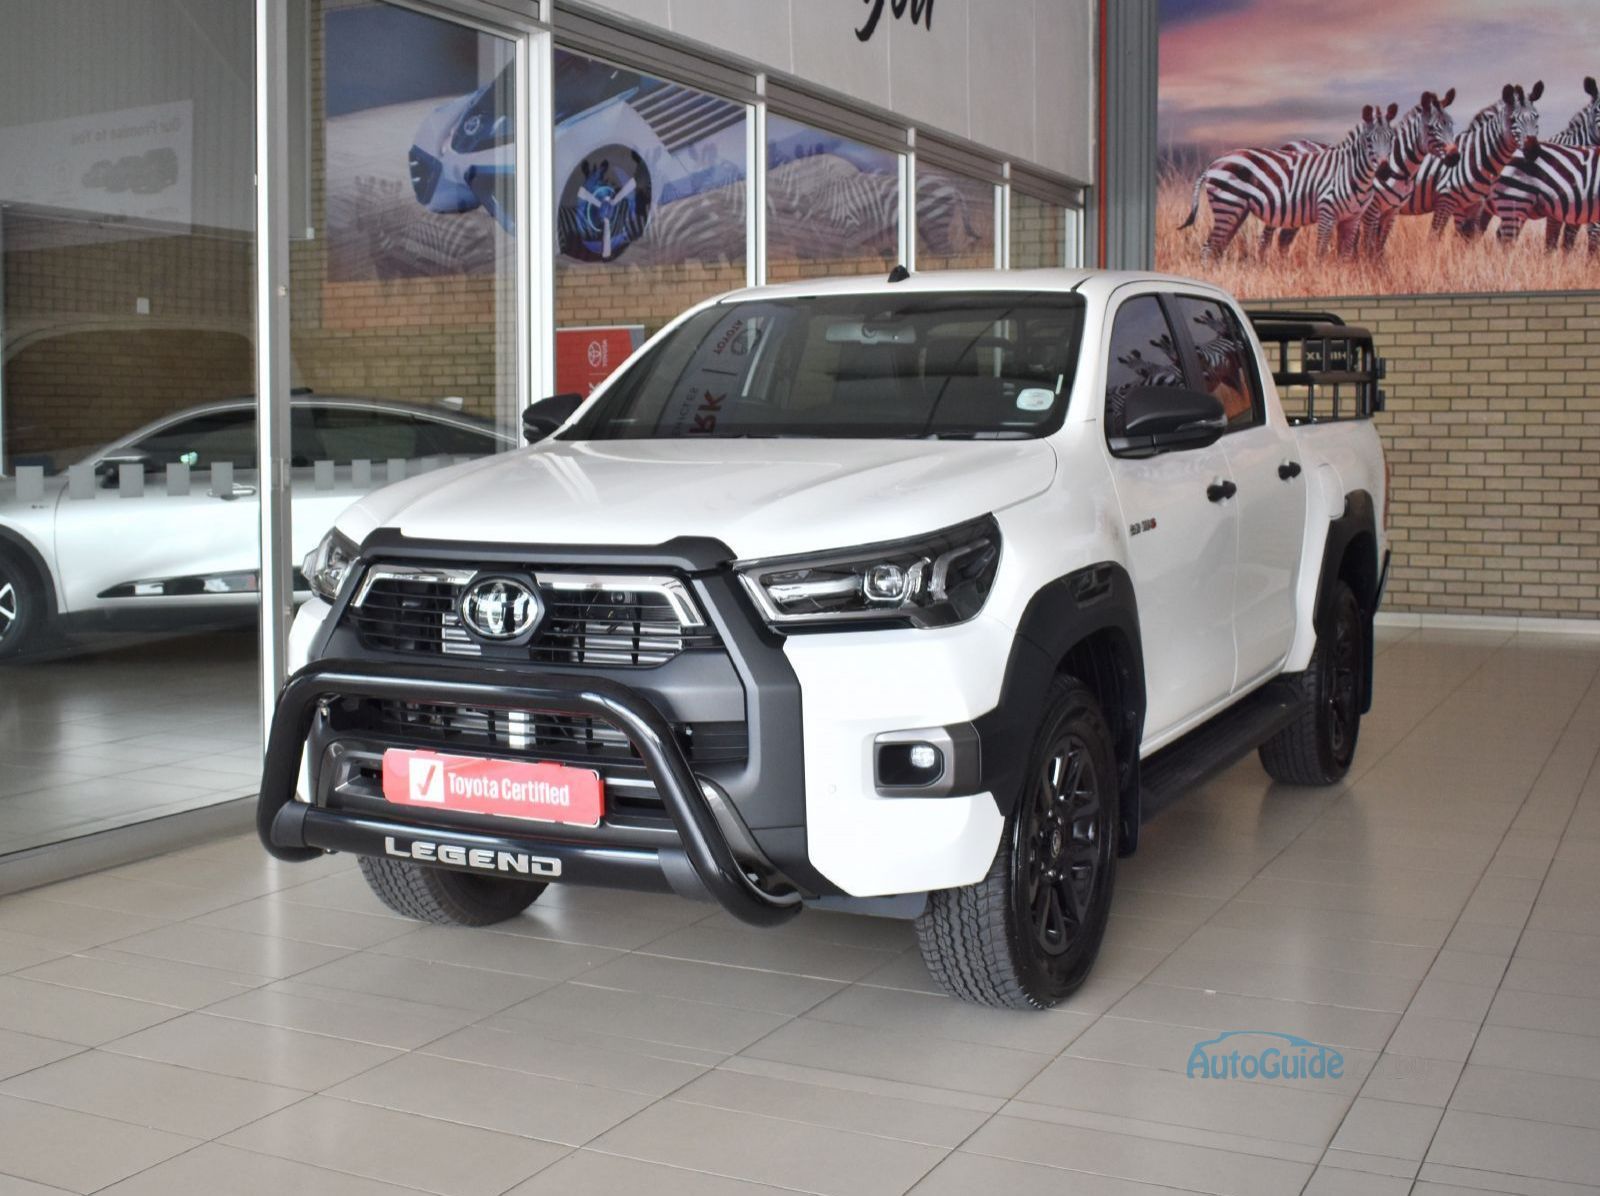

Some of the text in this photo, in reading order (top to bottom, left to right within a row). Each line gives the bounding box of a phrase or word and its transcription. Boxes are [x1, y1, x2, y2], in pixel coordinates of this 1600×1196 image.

[448, 772, 570, 807] Toyota Certified
[384, 836, 563, 877] LEGEND
